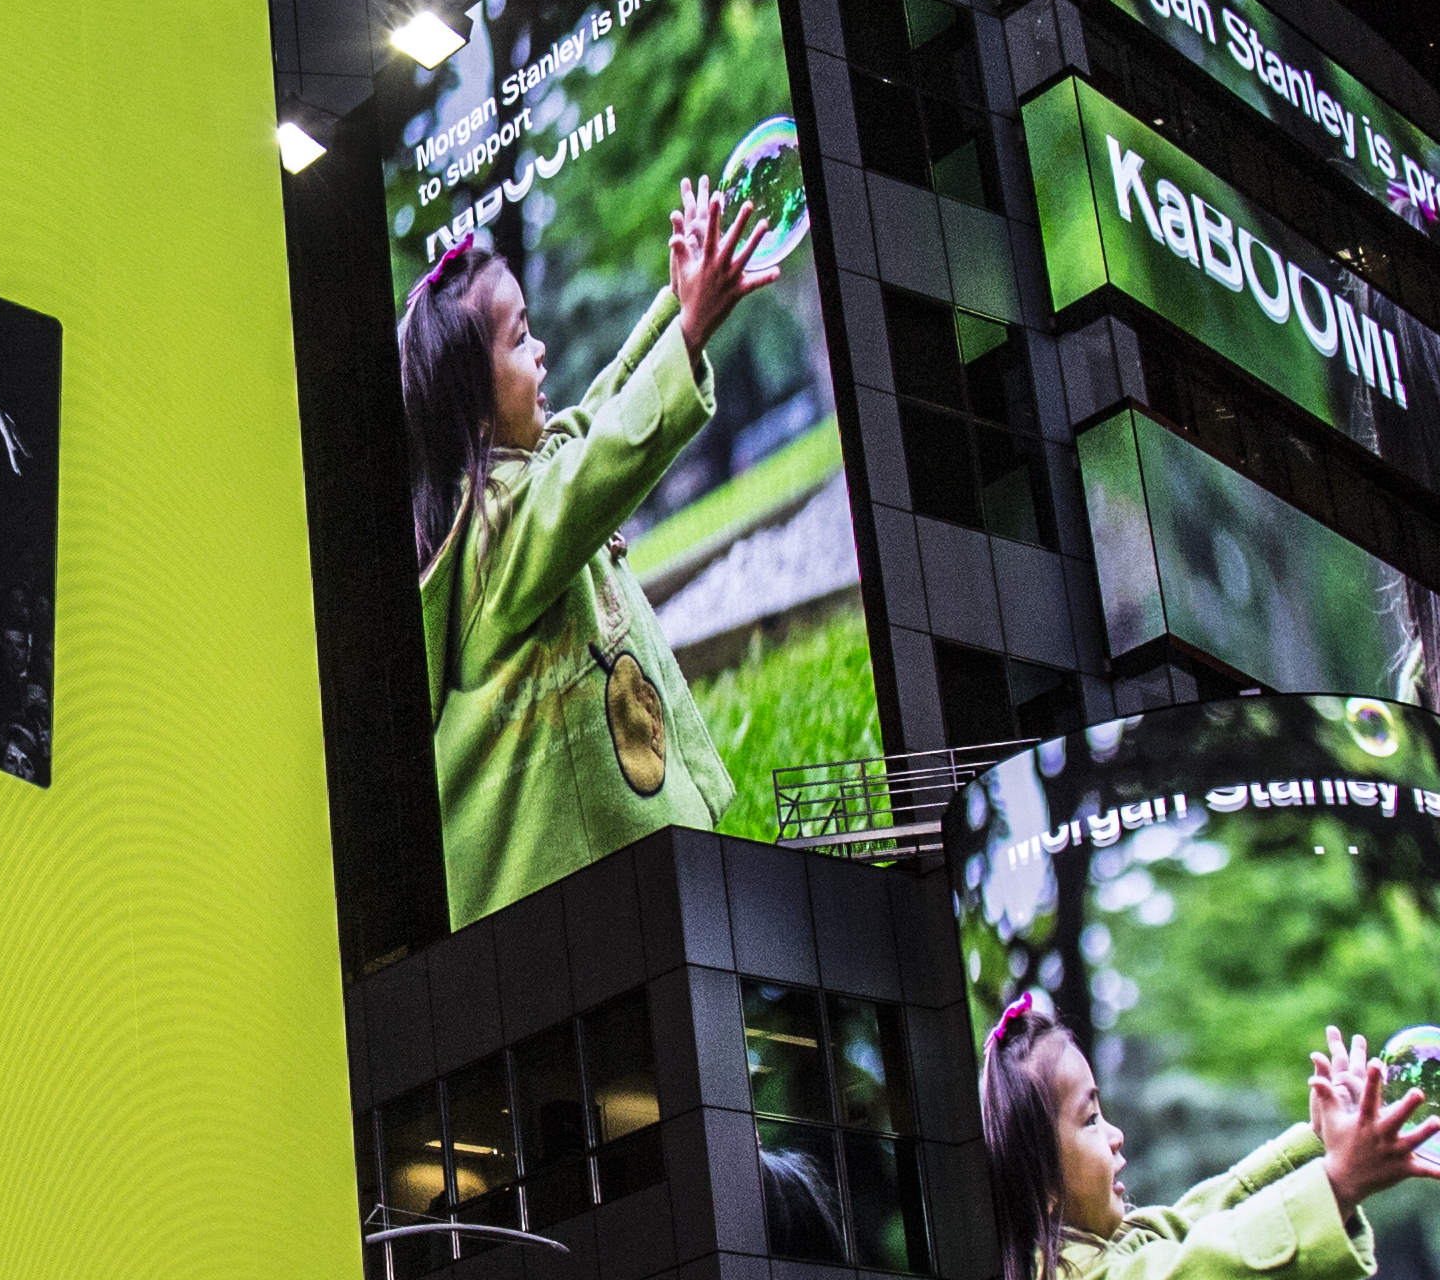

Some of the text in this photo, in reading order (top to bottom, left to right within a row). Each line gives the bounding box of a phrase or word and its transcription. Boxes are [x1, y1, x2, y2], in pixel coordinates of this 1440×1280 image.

[415, 97, 497, 172] Morgan
[502, 28, 586, 101] Stanley
[592, 12, 613, 41] is
[419, 107, 533, 207] to support
[1222, 8, 1357, 159] Stanley
[1363, 116, 1396, 178] is
[1105, 133, 1408, 410] KaBOOM!
